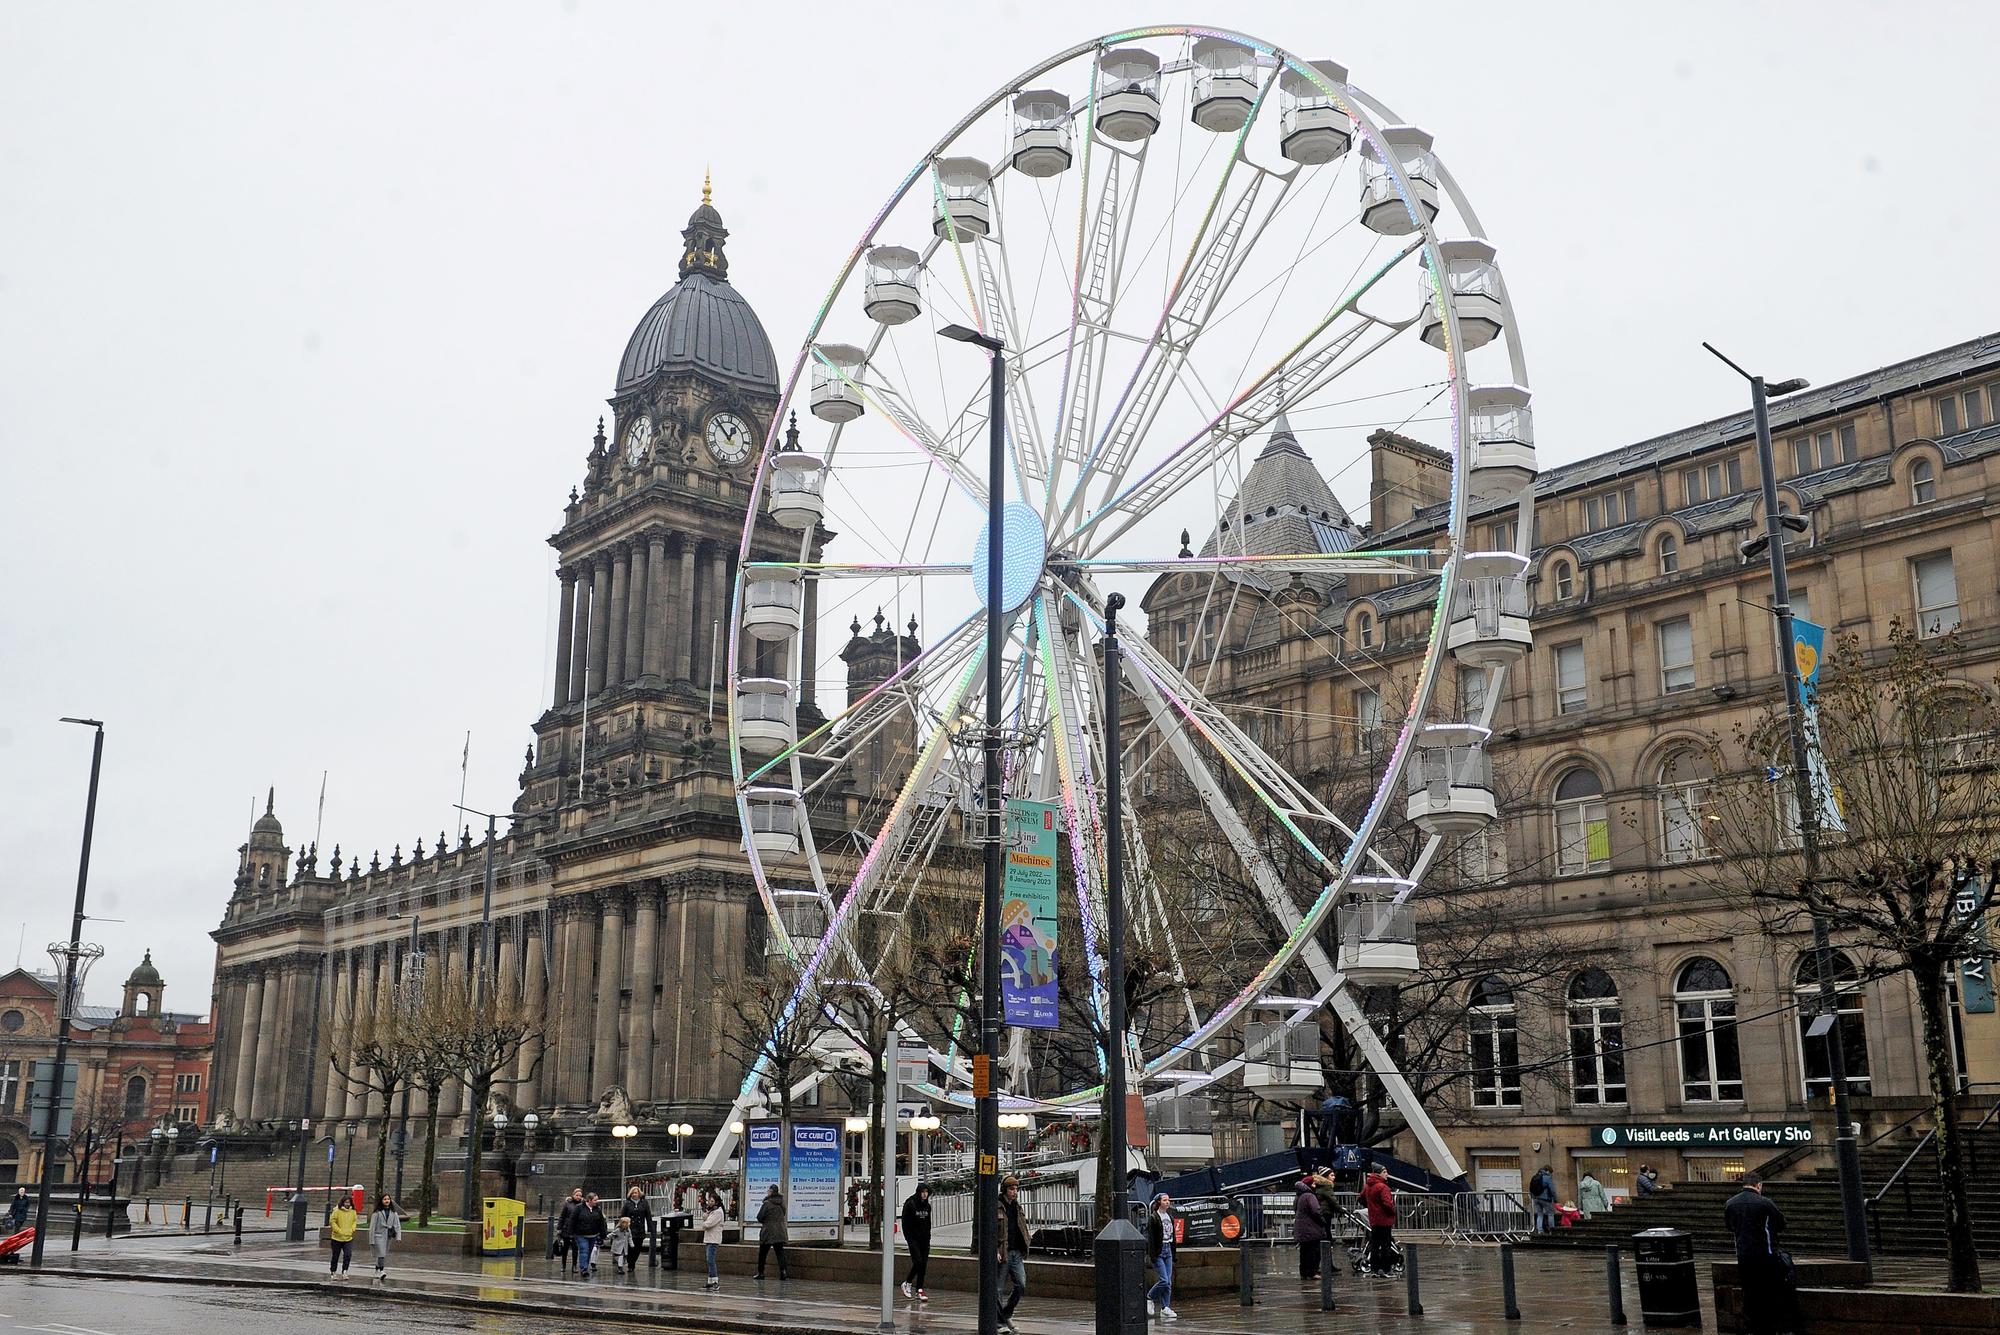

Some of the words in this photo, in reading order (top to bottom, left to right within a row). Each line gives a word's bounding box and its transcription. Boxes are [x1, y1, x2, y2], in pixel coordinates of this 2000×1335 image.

[1010, 853, 1051, 867] Machines
[1017, 869, 1028, 878] July
[1029, 870, 1043, 878] 2022
[1014, 876, 1037, 886] January
[1037, 878, 1051, 886] 2023
[1009, 890, 1021, 898] Free
[1022, 893, 1050, 901] exhibition
[808, 1132, 825, 1140] CUBE
[1625, 1127, 1690, 1142] VisitLeeds
[1693, 1131, 1705, 1139] and
[1708, 1127, 1730, 1141] Art
[1733, 1127, 1781, 1145] Gallery
[981, 1156, 994, 1171] H
